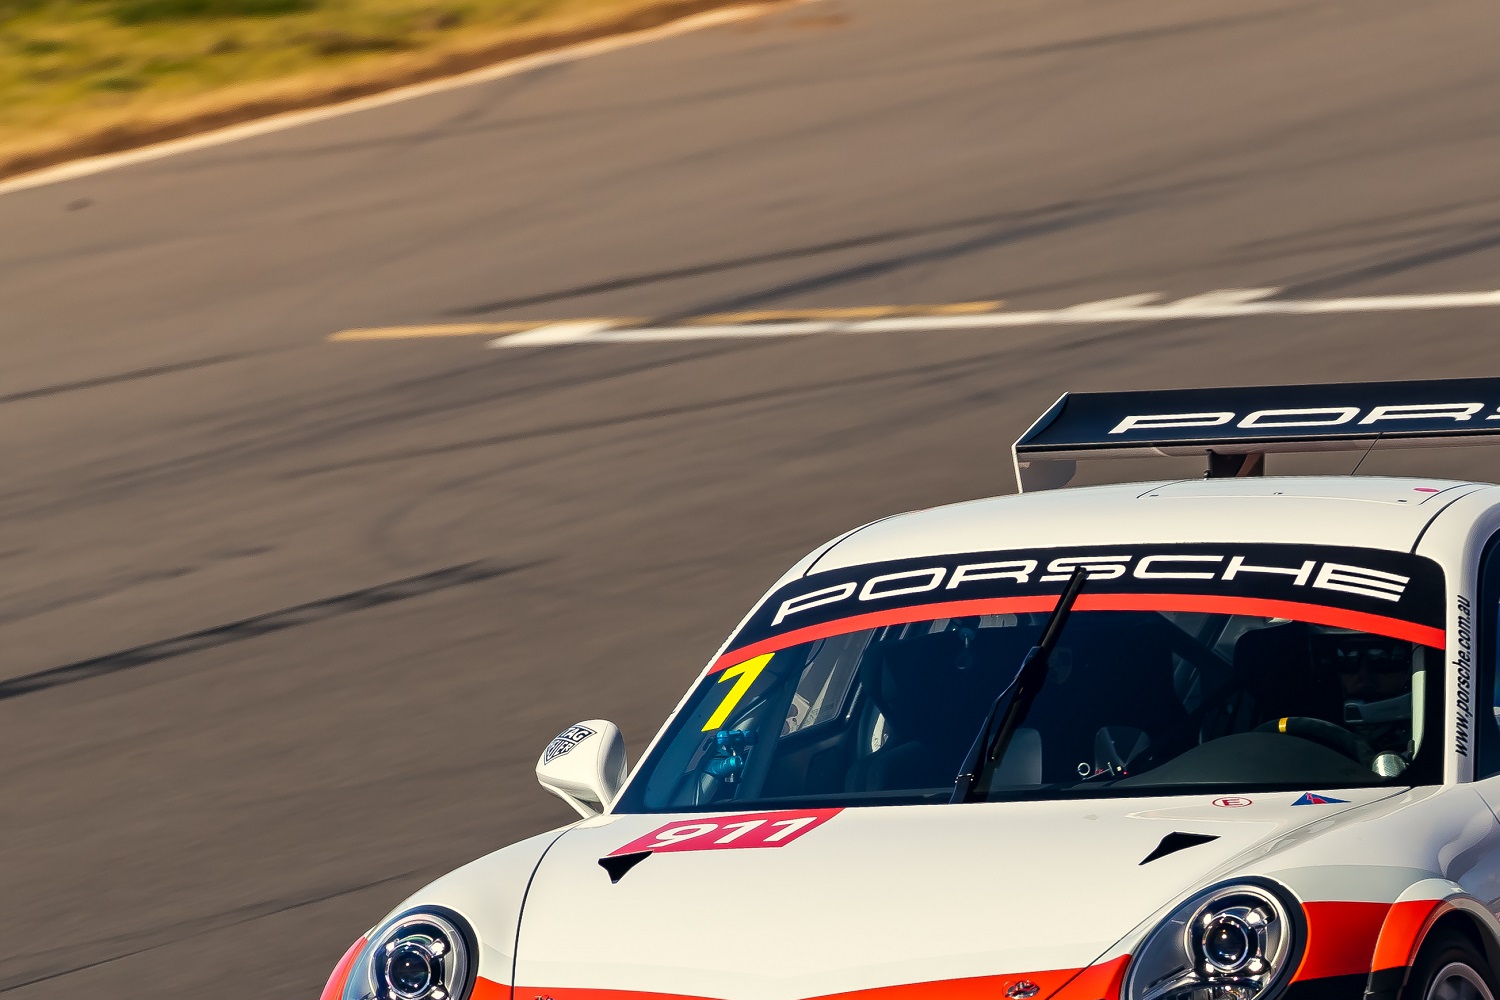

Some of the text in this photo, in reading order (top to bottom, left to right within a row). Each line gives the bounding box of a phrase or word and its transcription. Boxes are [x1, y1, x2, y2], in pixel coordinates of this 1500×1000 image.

[770, 555, 1411, 626] PORSCHE
[701, 652, 776, 732] 1
[1452, 594, 1473, 758] www.porsche.com.au
[647, 816, 818, 848] 911
